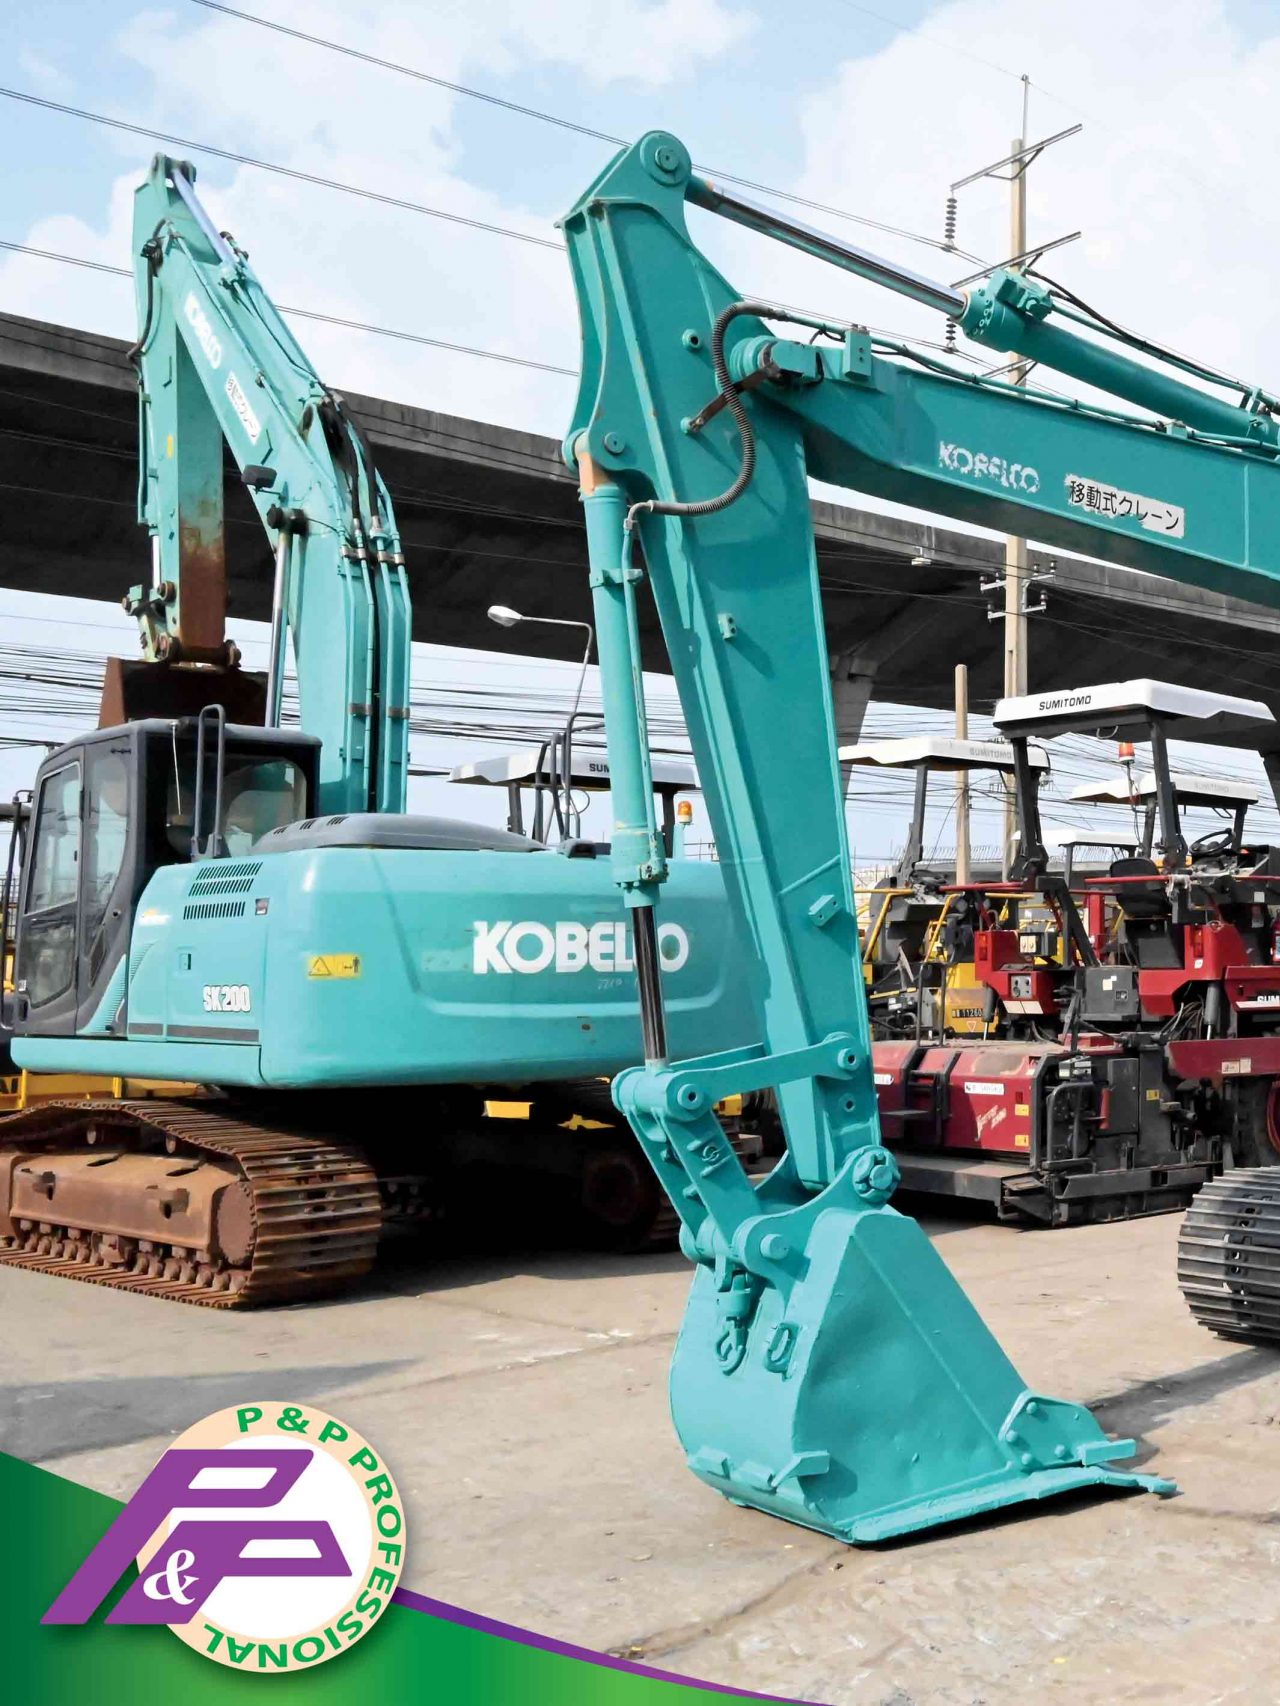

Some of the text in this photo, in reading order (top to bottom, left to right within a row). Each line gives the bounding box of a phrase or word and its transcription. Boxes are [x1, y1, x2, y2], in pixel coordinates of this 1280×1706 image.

[1069, 480, 1180, 531] 移動式クレーン
[1038, 695, 1092, 711] SUMITOMO
[473, 921, 689, 974] KOBELO
[203, 985, 251, 1012] SK200
